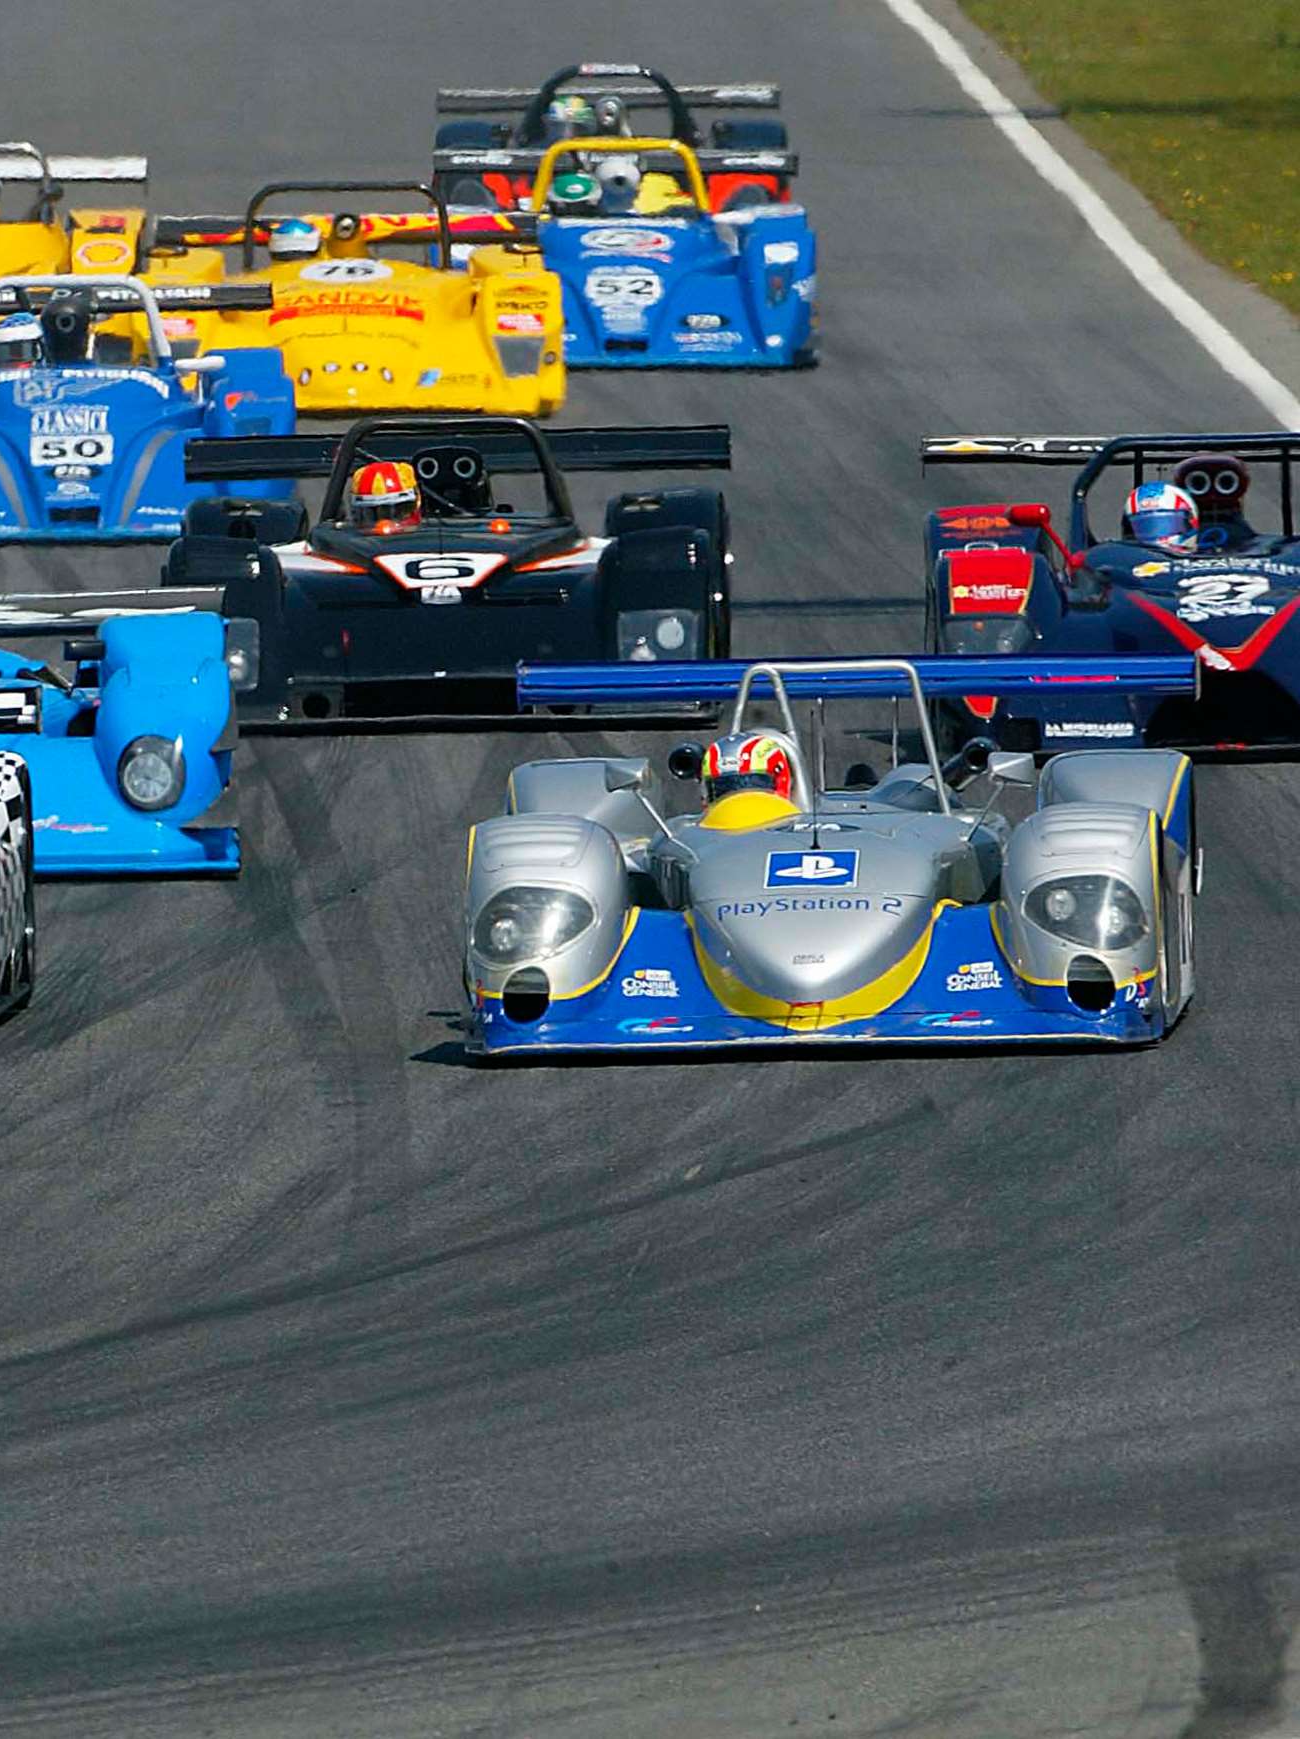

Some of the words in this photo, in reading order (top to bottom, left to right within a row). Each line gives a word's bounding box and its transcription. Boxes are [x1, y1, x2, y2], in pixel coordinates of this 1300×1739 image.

[596, 278, 654, 296] 52
[41, 438, 105, 460] 50
[405, 557, 476, 581] 6
[717, 897, 870, 921] PlayStation
[882, 896, 902, 917] 2
